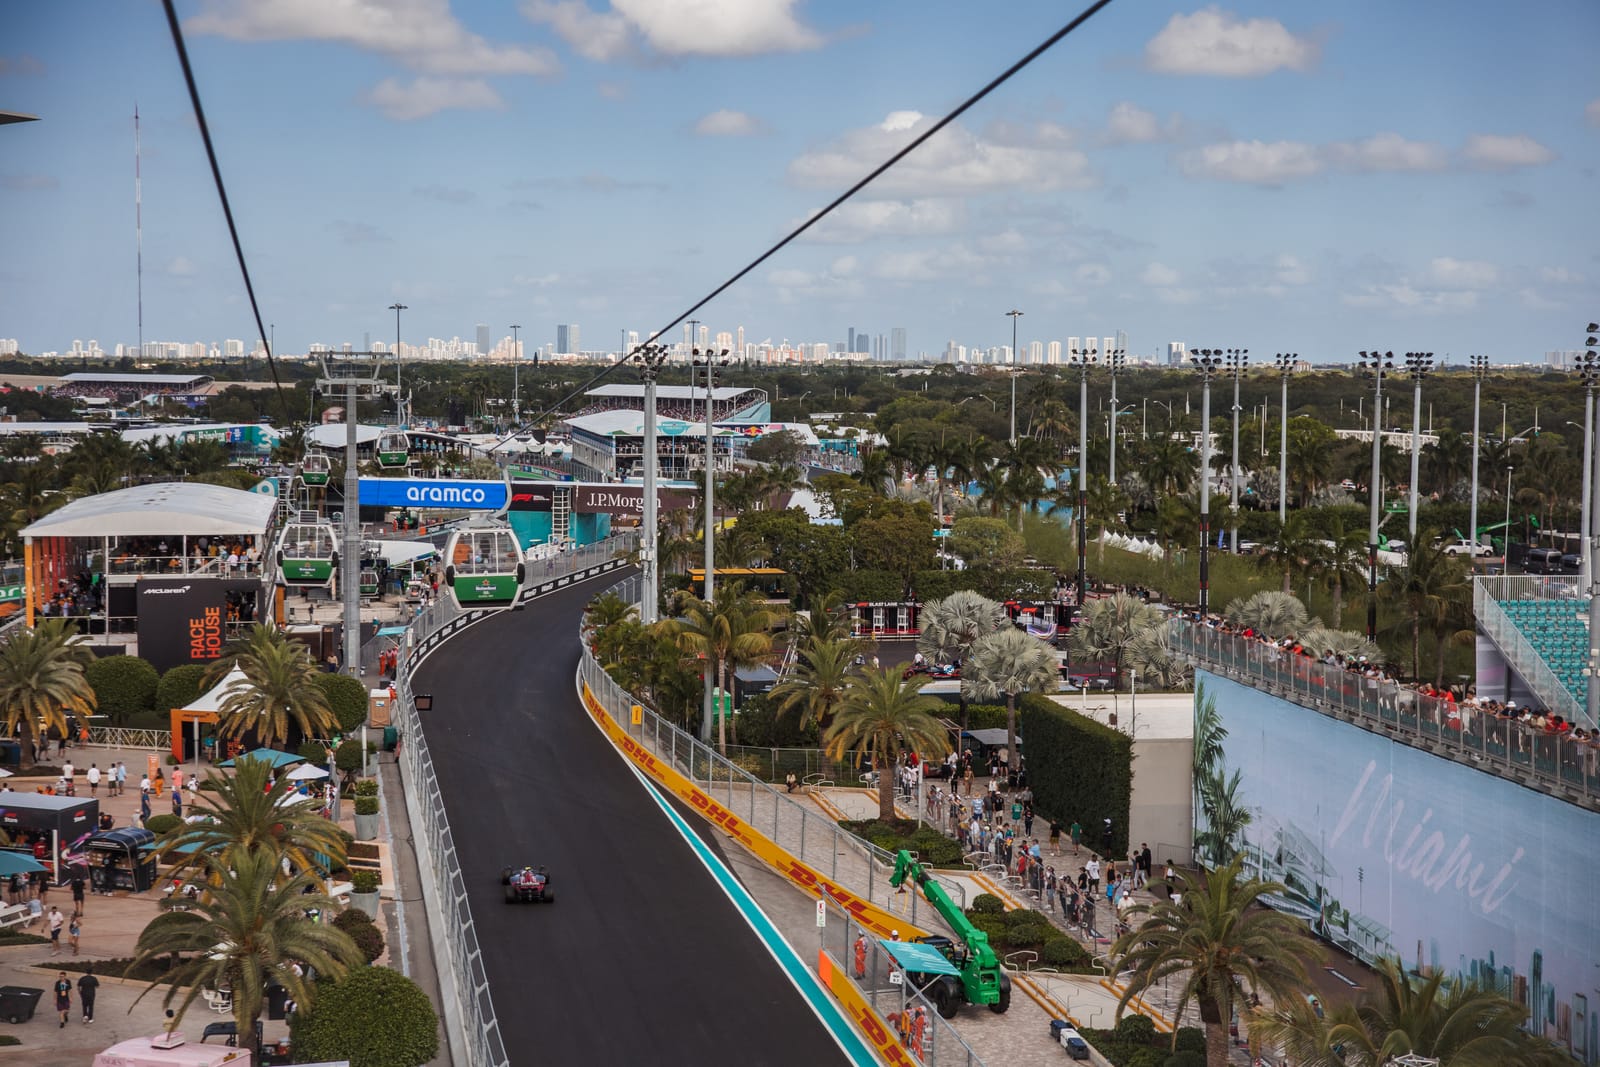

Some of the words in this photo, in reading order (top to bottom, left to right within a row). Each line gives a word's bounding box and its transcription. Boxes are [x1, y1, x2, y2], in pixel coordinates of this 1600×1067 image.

[406, 487, 486, 502] aramco
[587, 493, 662, 512] J.P.Morgn
[143, 586, 188, 595] McLaren
[190, 618, 206, 659] RACE
[205, 607, 221, 659] HOUSE
[623, 735, 657, 773] DHL
[689, 789, 742, 837] DHL
[1329, 759, 1525, 914] Miami
[788, 860, 875, 925] DHL
